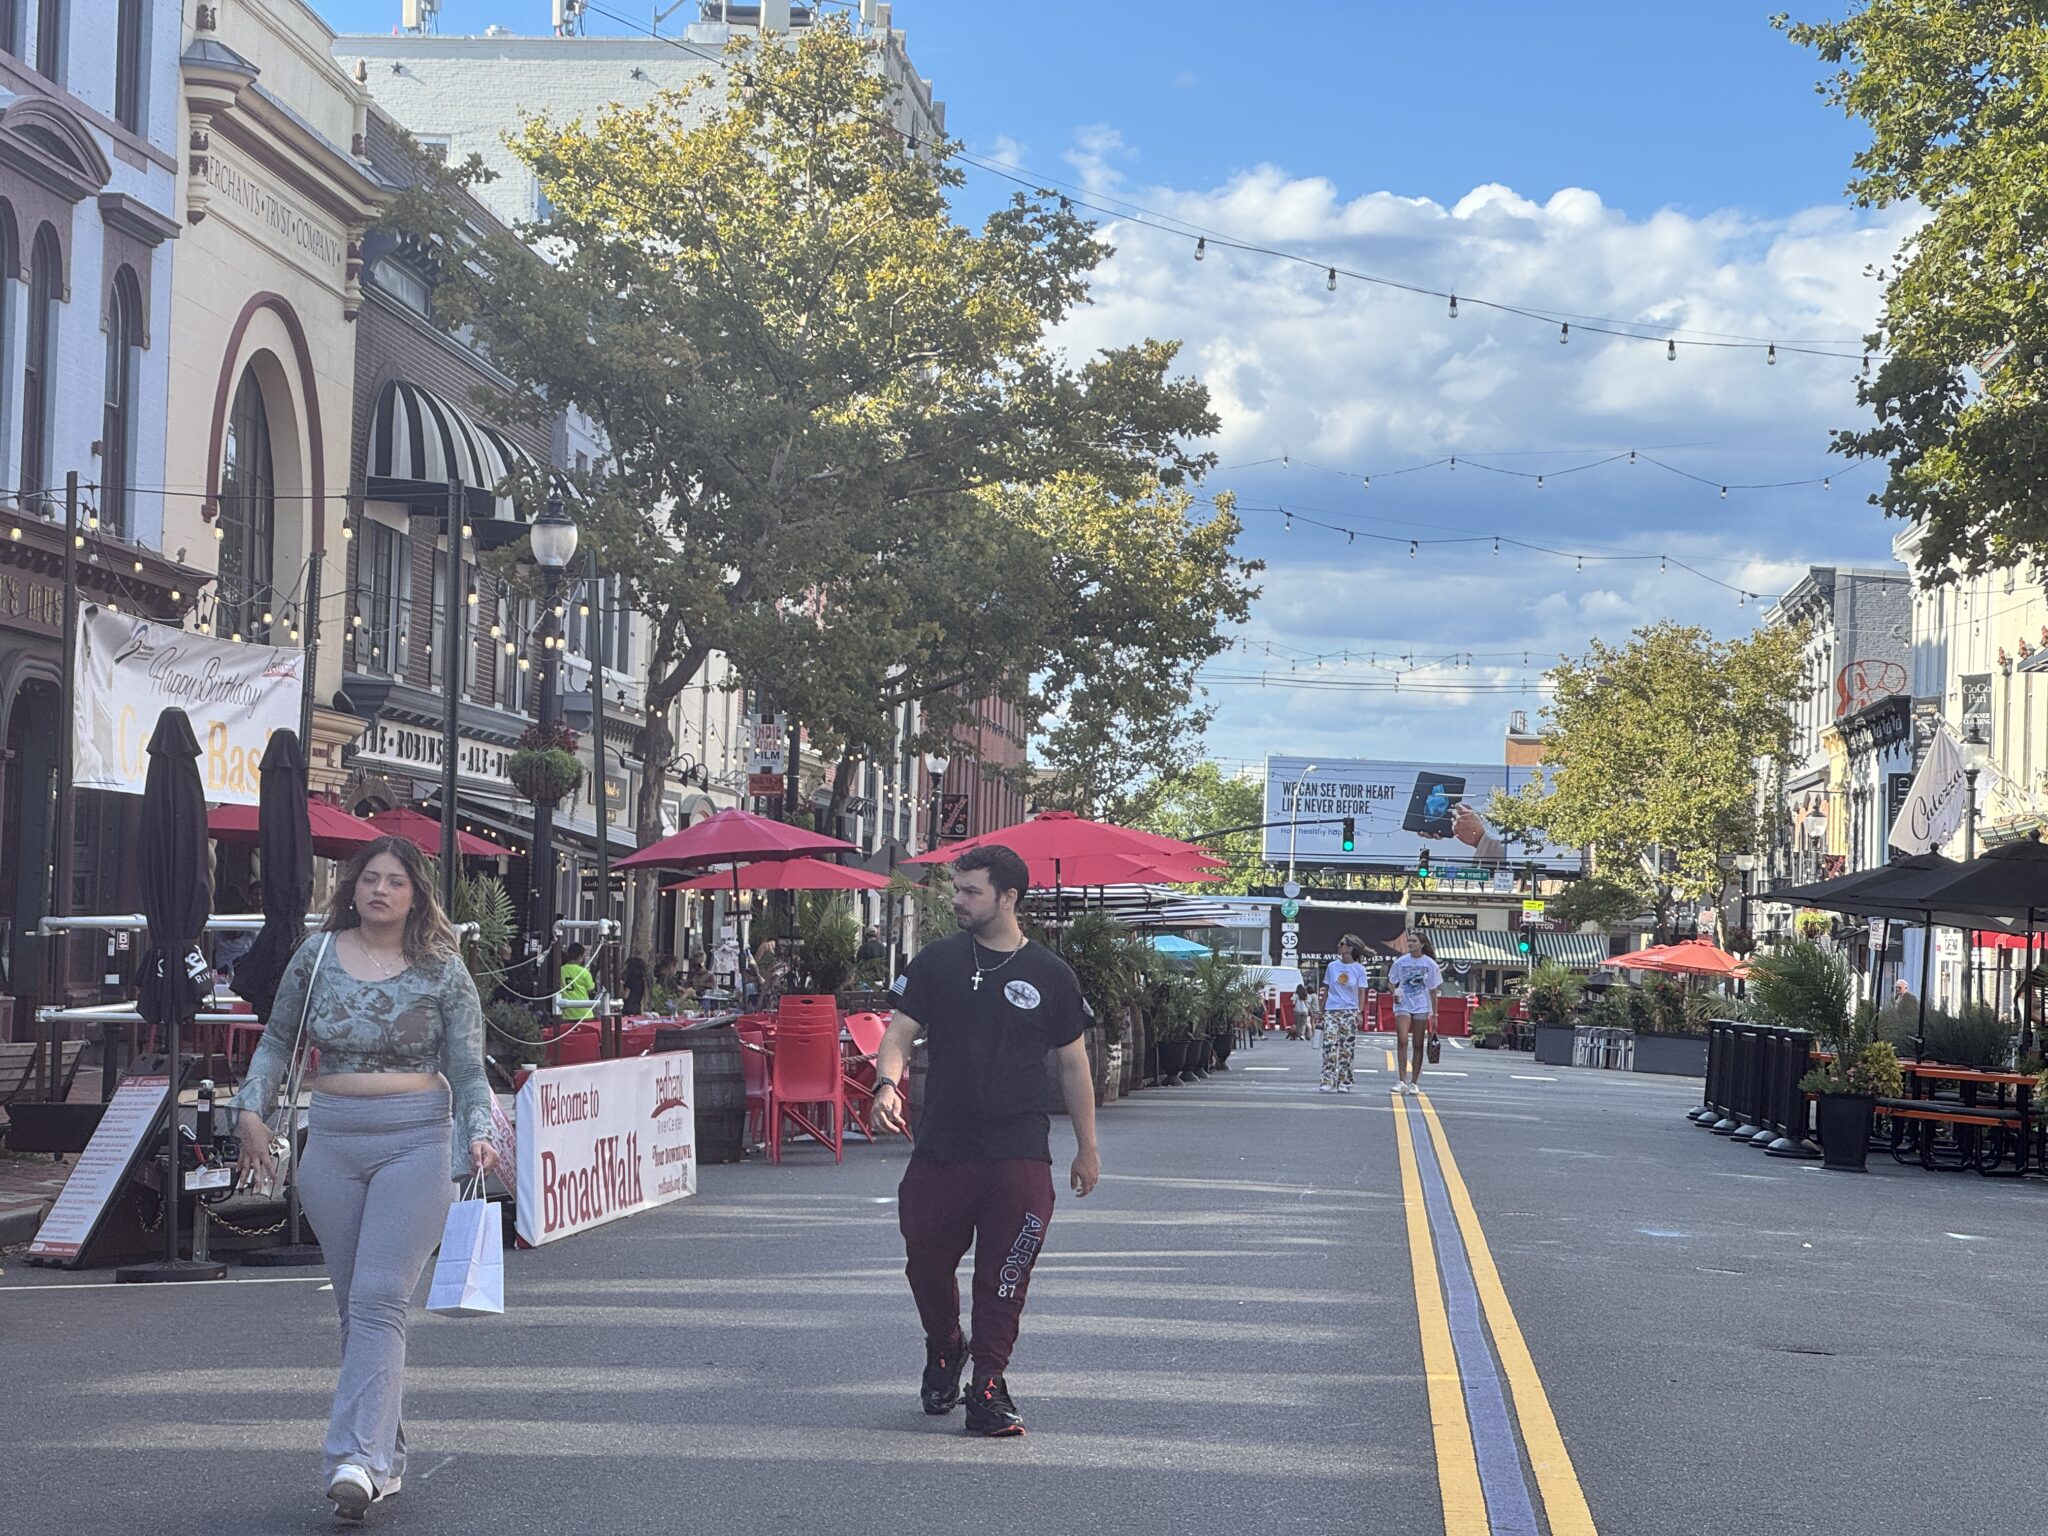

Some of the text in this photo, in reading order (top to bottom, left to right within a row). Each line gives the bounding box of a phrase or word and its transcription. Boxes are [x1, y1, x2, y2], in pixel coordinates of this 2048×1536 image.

[205, 155, 260, 216] ERCHANTS
[296, 217, 338, 268] COMPANY
[28, 582, 64, 627] MUS
[149, 646, 263, 719] Happy Birthday
[396, 730, 443, 765] ROBINS
[468, 746, 488, 774] ALE
[754, 751, 780, 760] FILM
[1282, 798, 1373, 815] LIE NEVER BEFORE.
[1299, 783, 1318, 797] CAN
[1320, 783, 1337, 798] SEE
[1339, 784, 1364, 799] YOUR
[1366, 784, 1396, 800] HEART
[120, 932, 129, 944] B
[1283, 935, 1298, 945] 35
[1418, 913, 1475, 926] APPRAISERS
[655, 1059, 685, 1105] redbank
[540, 1082, 599, 1128] Welcome to
[541, 1130, 644, 1233] BroadWalk
[1000, 1212, 1044, 1286] AERO
[998, 1284, 1016, 1298] 87
